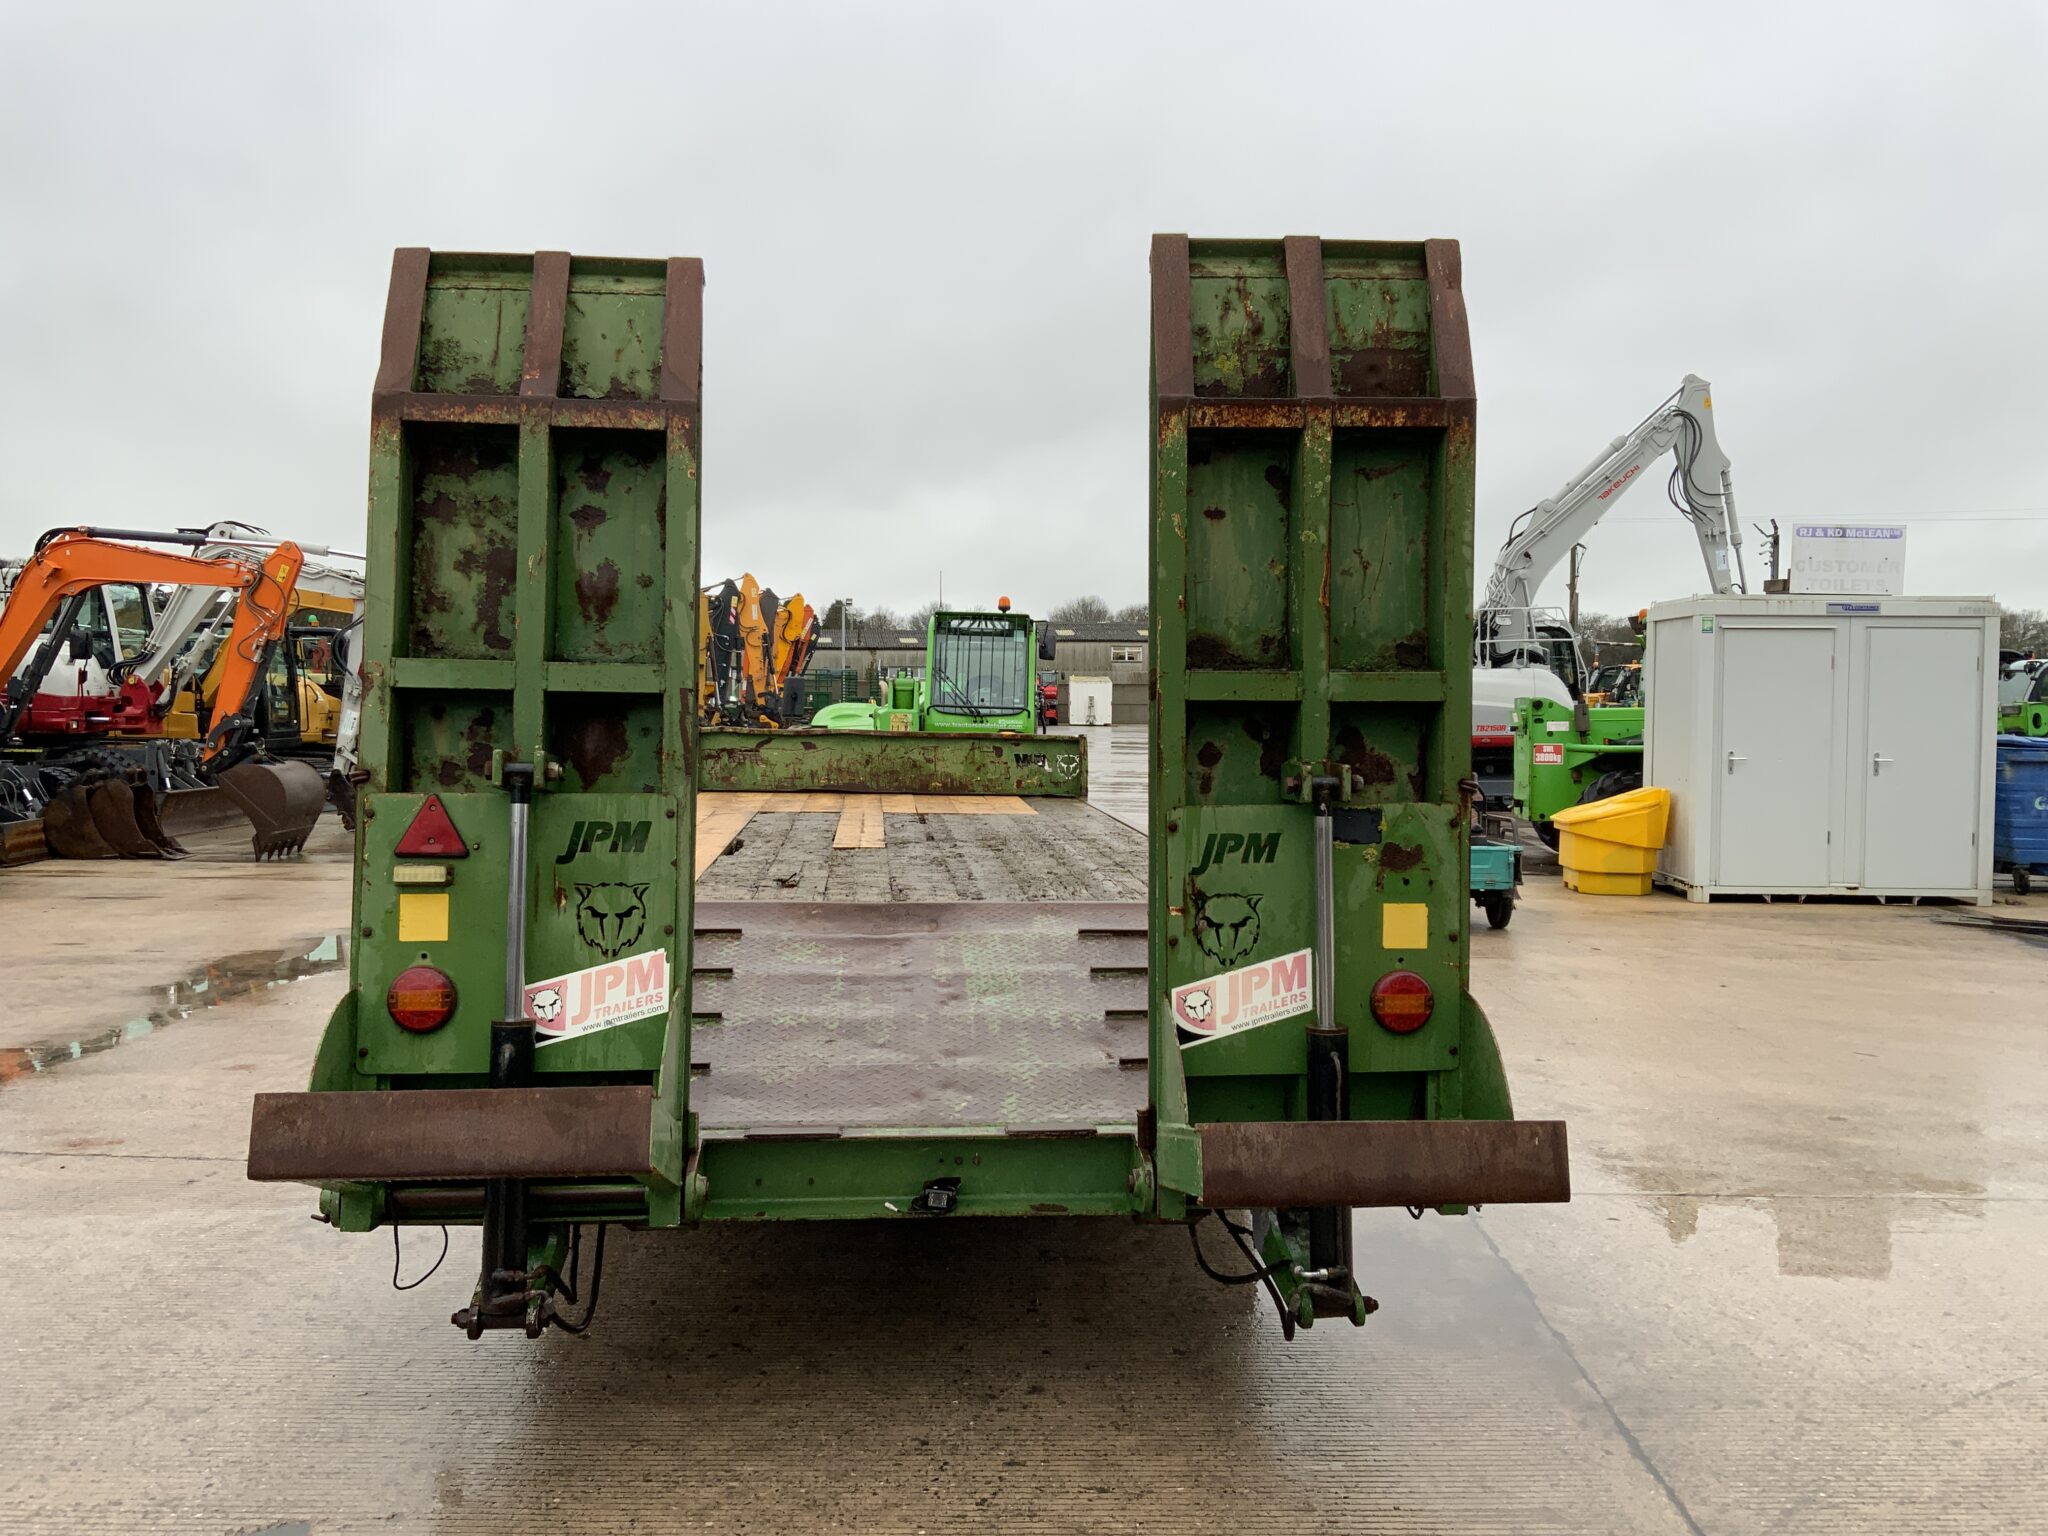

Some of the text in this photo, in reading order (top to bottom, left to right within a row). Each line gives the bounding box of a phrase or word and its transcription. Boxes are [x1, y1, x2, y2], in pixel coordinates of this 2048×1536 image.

[1800, 528, 1813, 537] RJ
[1815, 528, 1825, 537] &
[1827, 528, 1843, 537] KD
[1846, 528, 1890, 538] McLEAN
[1795, 559, 1900, 574] CUSTOMER
[1808, 578, 1887, 592] TOILETS
[555, 821, 652, 865] JPM
[1189, 832, 1283, 876] JPM
[570, 953, 665, 1026] JPM
[1221, 954, 1307, 1025] JPM
[581, 1003, 665, 1032] www.jpmtrailers.com
[594, 991, 664, 1019] TRAILERS
[1231, 1003, 1309, 1031] www.jpmtrailers.com
[1242, 991, 1307, 1018] TRAILERS
